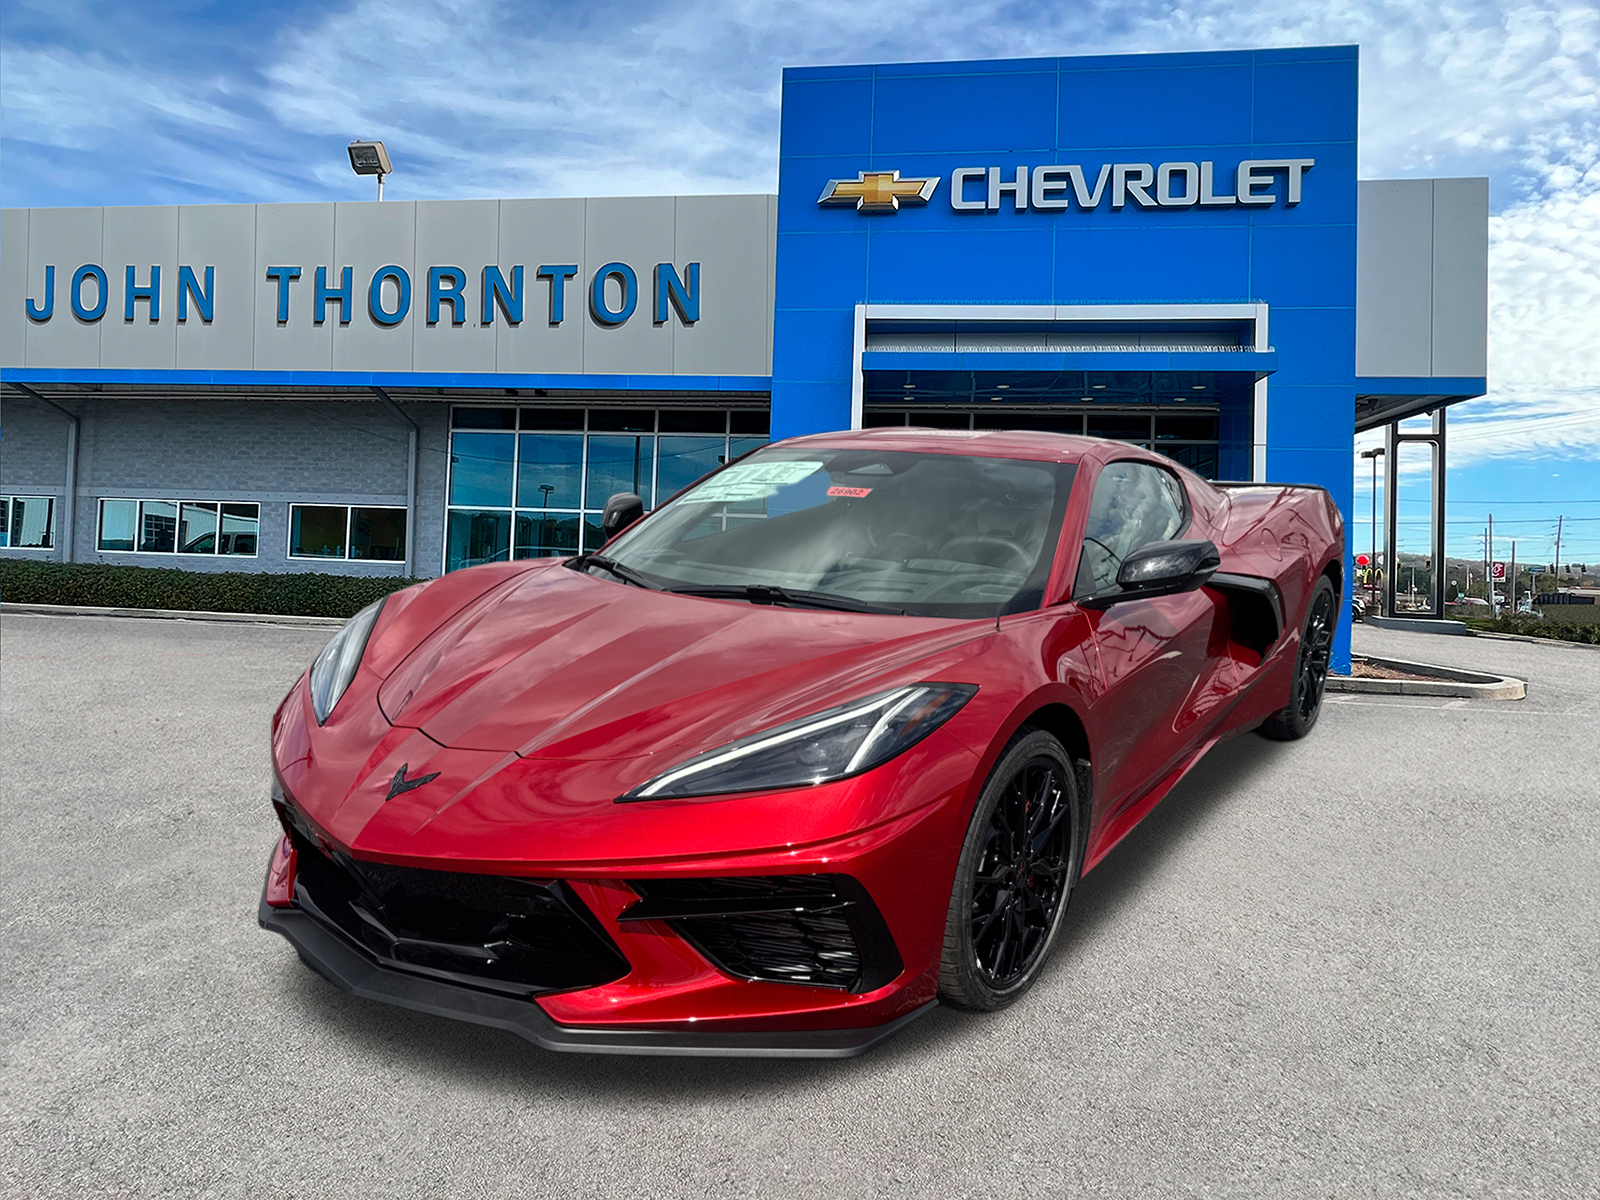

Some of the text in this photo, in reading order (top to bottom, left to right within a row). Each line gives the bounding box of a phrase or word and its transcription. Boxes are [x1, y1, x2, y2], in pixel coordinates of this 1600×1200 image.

[951, 158, 1315, 211] CHEVROLET
[25, 261, 701, 327] JOHN THORNTON
[830, 488, 864, 496] 26902
